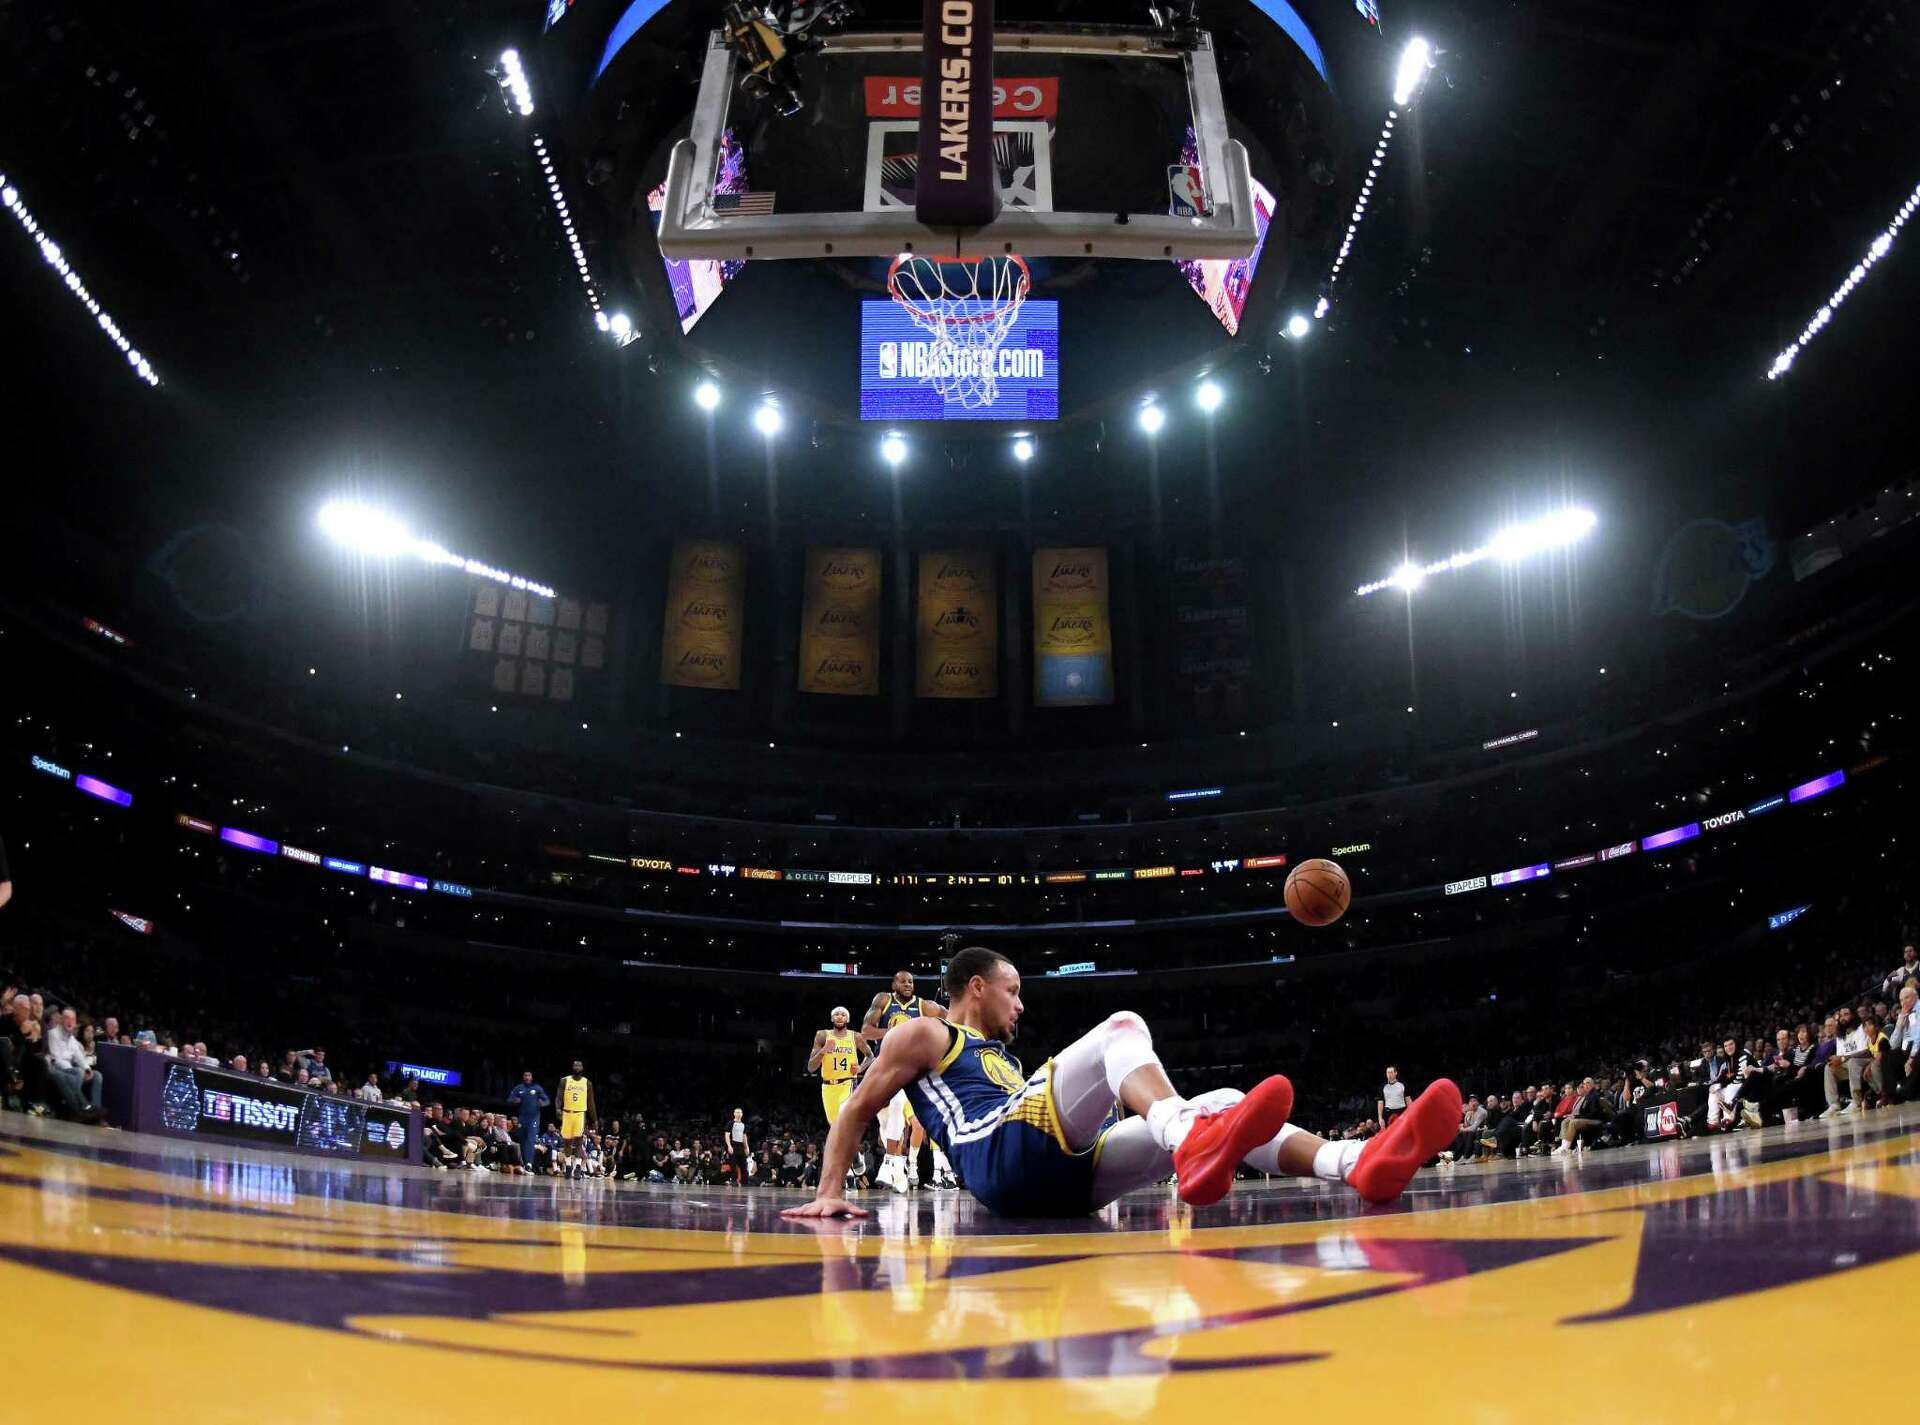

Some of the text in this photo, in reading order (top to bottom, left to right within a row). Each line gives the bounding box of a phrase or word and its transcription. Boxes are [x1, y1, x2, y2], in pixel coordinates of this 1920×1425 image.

[900, 340, 1044, 380] NBAStore.com
[31, 755, 71, 780] Spectrum
[1702, 810, 1745, 831] TOYOTA
[283, 845, 321, 866] TOSHIBA
[1331, 843, 1371, 857] Spectrum
[631, 857, 673, 871] TOYOTA
[795, 873, 826, 881] DELTA
[829, 873, 870, 883] STAPLES
[1134, 866, 1176, 879] TOSHIBA
[442, 883, 472, 897] DELTA
[1446, 877, 1486, 895] STAPLES
[833, 1056, 848, 1071] 14
[420, 1069, 447, 1081] LIGHT
[230, 1095, 299, 1131] TISSOT
